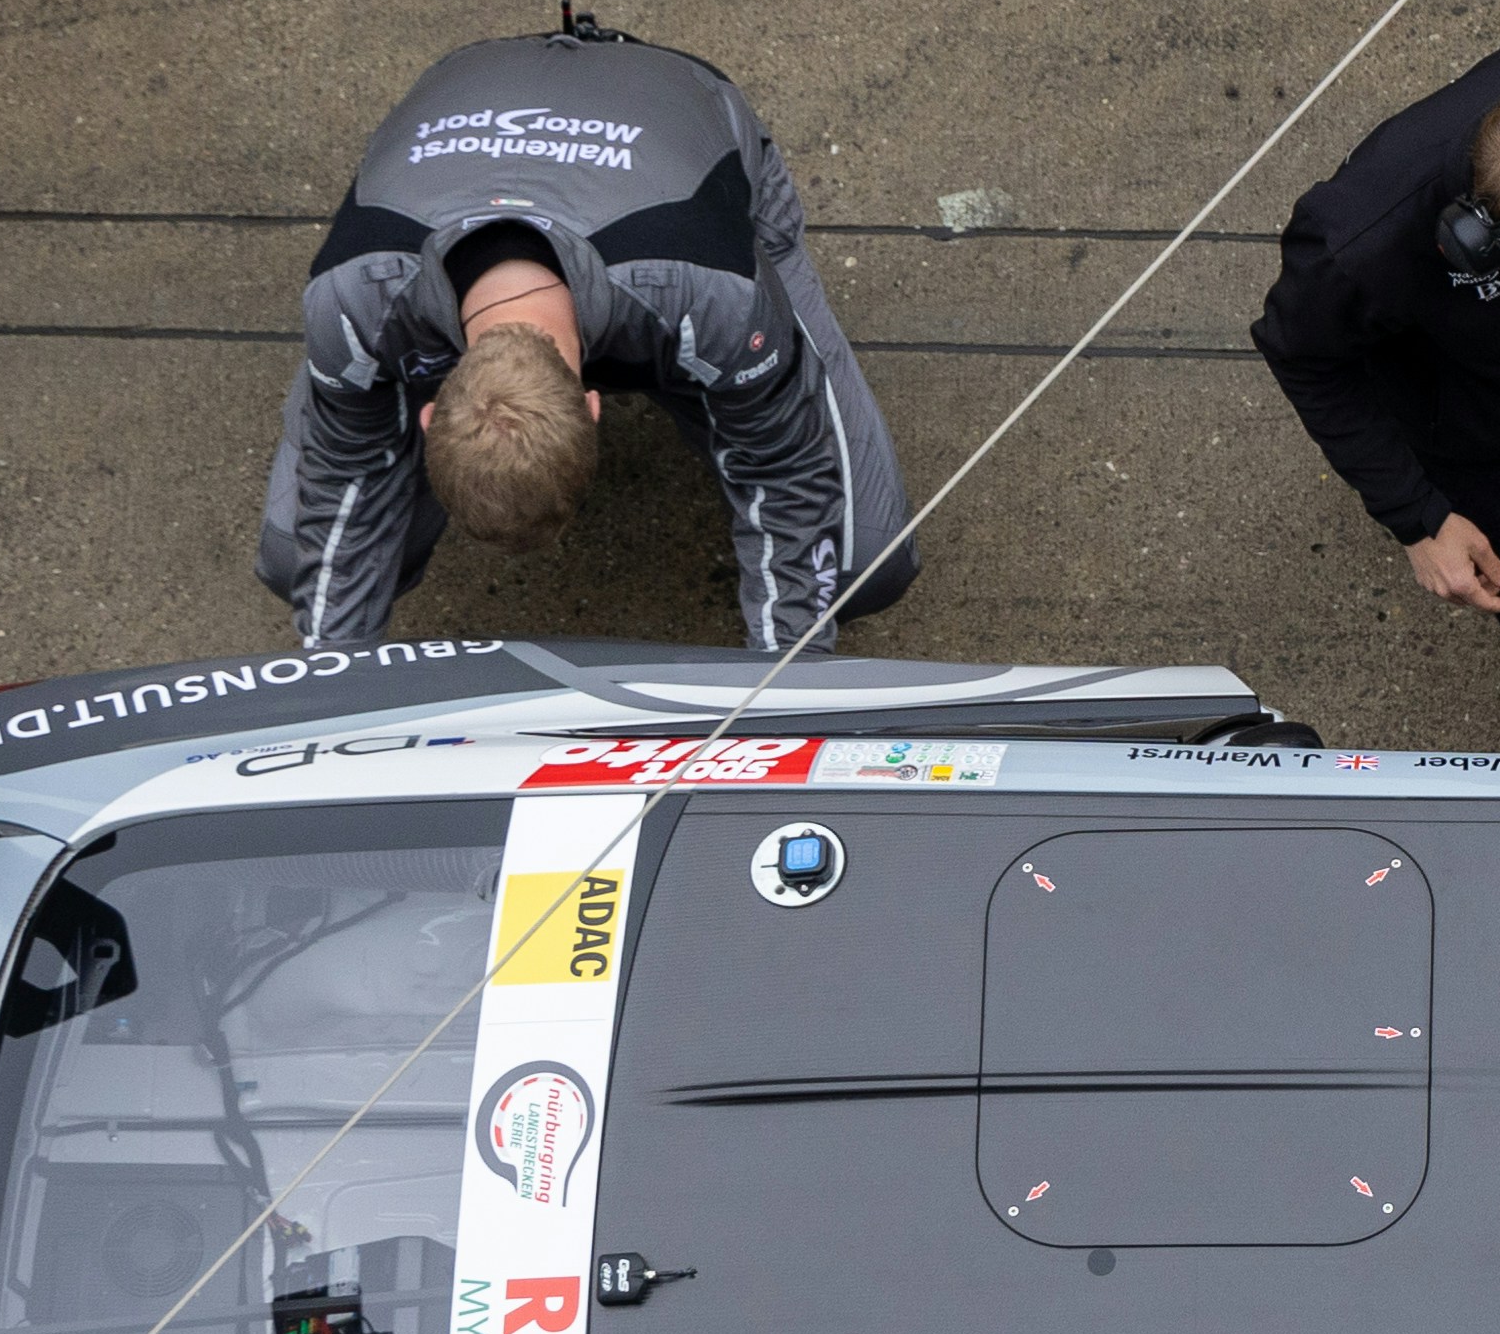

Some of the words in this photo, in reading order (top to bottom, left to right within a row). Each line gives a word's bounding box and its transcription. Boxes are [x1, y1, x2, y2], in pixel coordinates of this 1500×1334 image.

[409, 137, 633, 171] Walkenhorst
[539, 737, 809, 770] auto
[630, 757, 778, 784] sport
[1127, 746, 1283, 770] Warhurst
[1298, 752, 1322, 770] J.
[568, 875, 620, 979] ADAC
[509, 1112, 526, 1150] SERIE
[535, 1087, 562, 1205] nürburgring
[519, 1102, 542, 1200] LANGSTRECKEN
